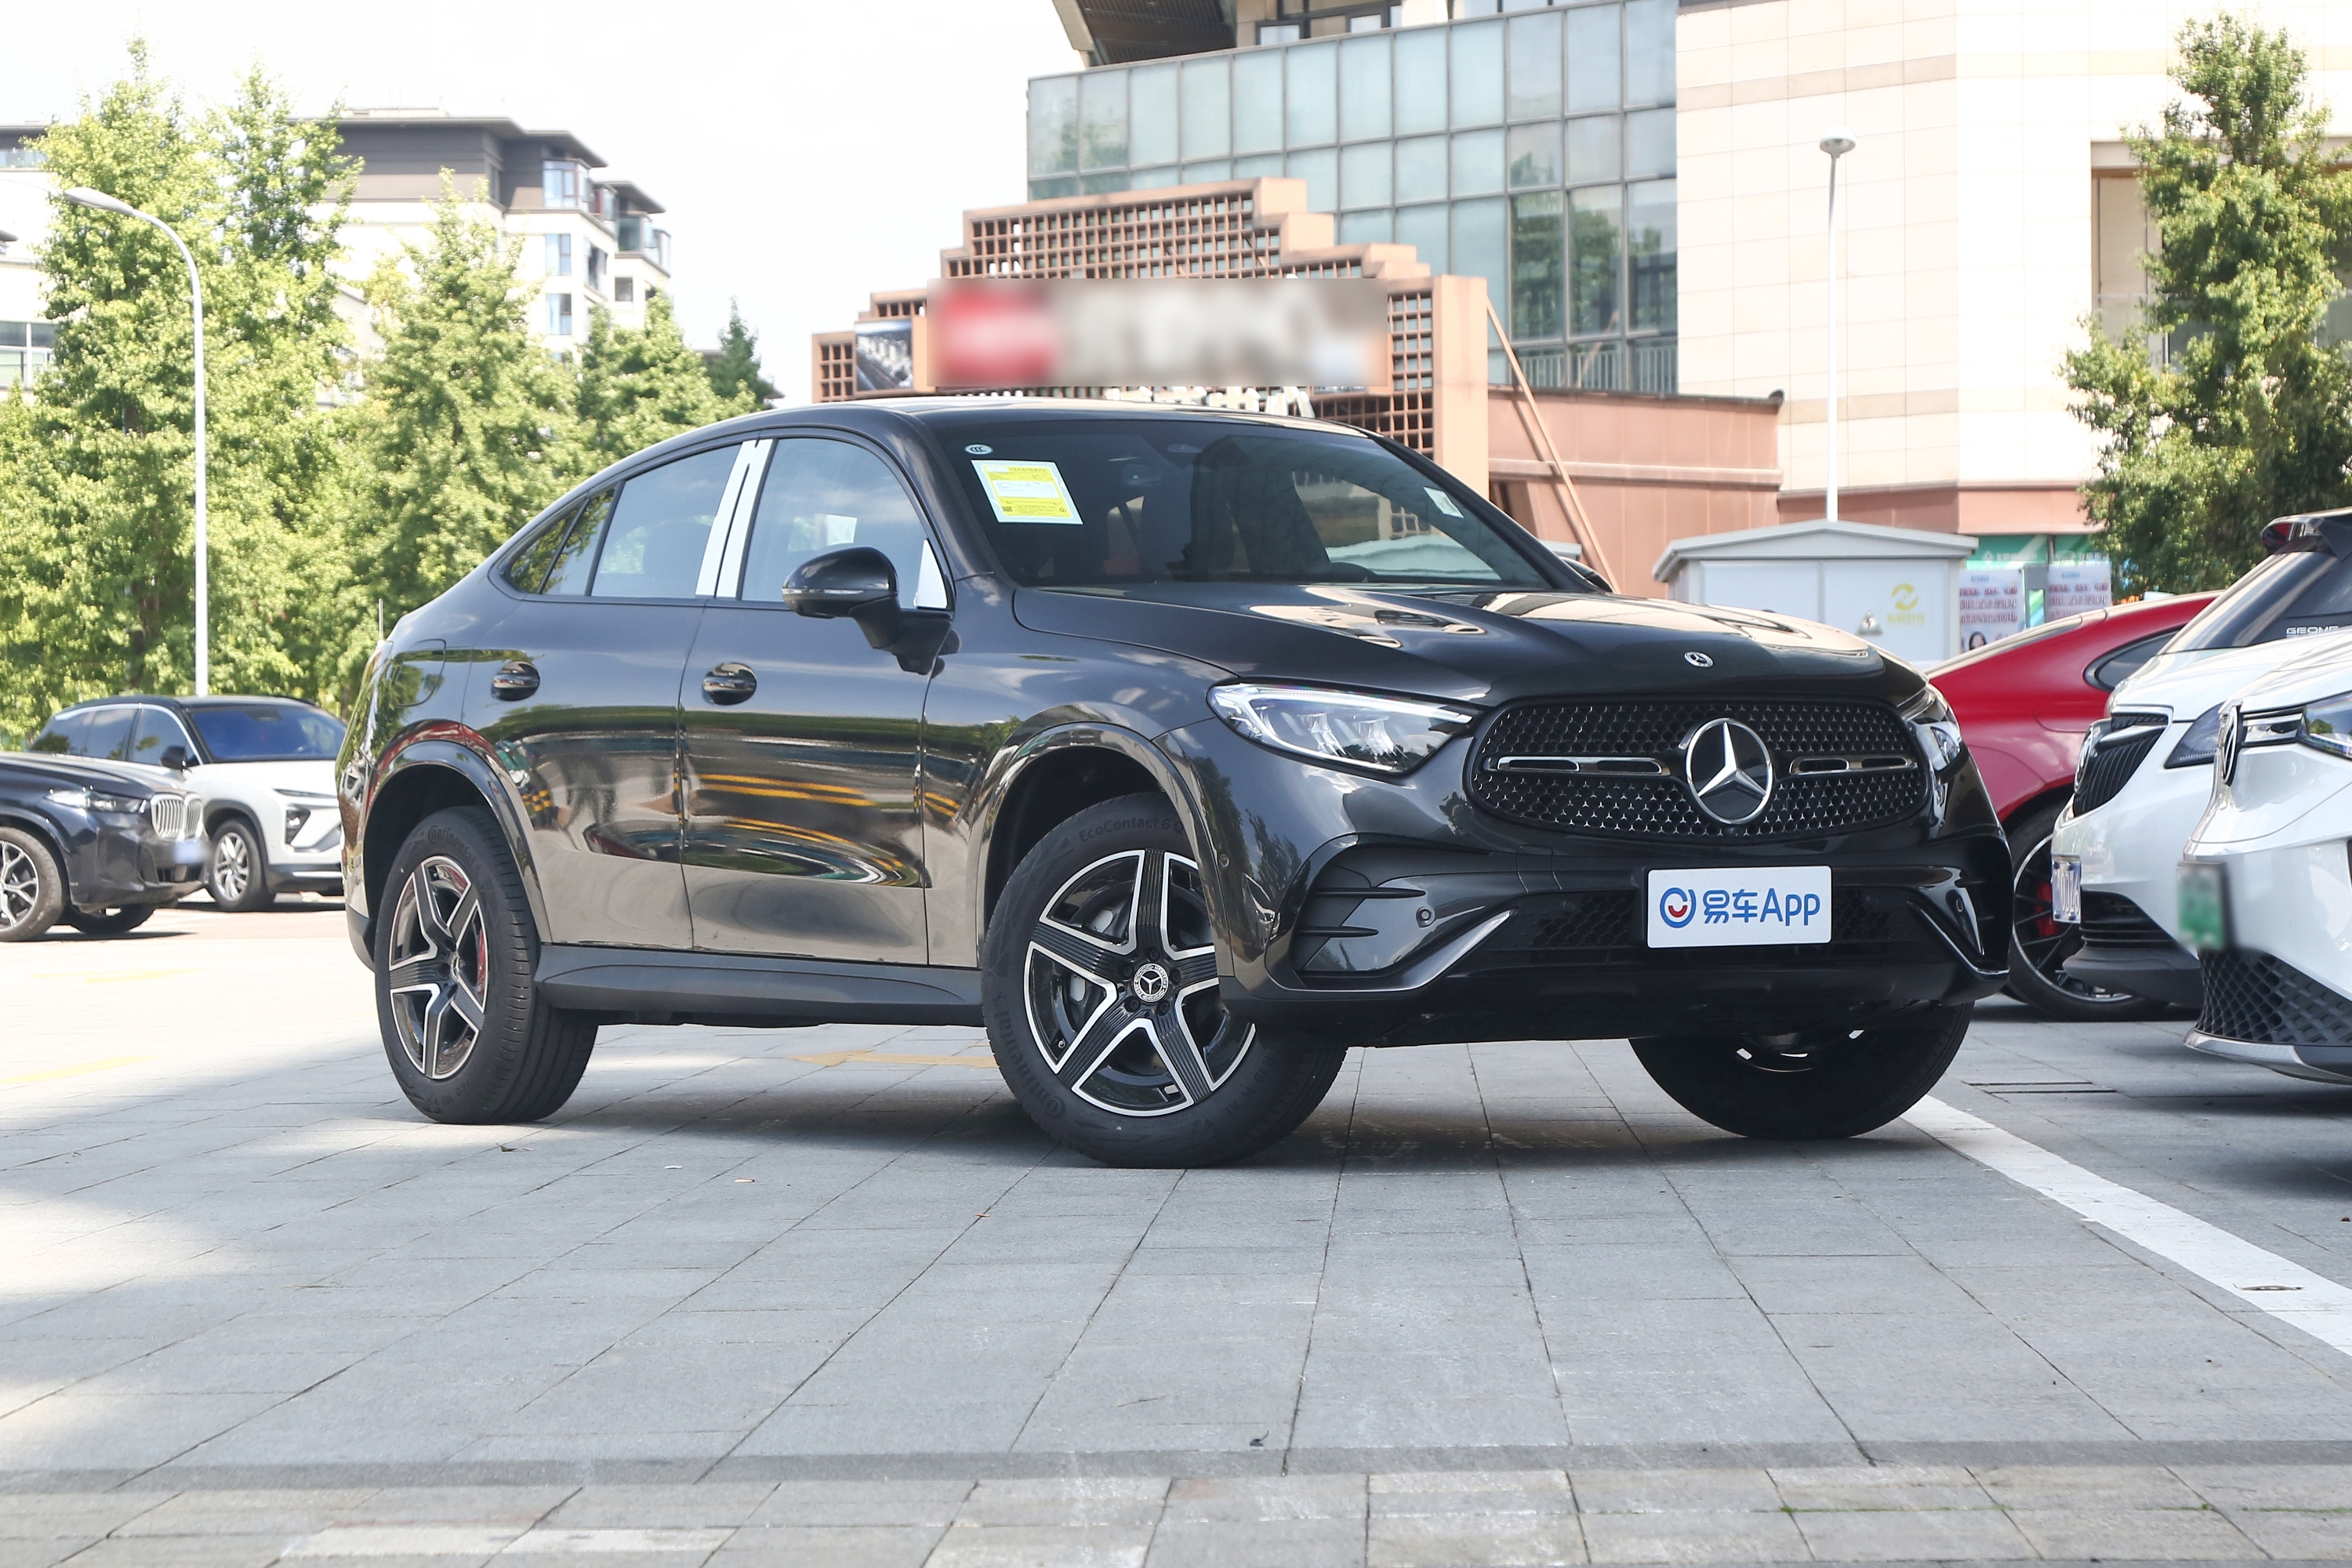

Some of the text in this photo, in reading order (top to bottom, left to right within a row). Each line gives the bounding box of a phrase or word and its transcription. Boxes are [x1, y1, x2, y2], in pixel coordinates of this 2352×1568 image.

[427, 824, 476, 865] Continental
[1079, 817, 1159, 843] EcoContact
[1162, 818, 1171, 830] 6
[1702, 887, 1821, 927] 易车App
